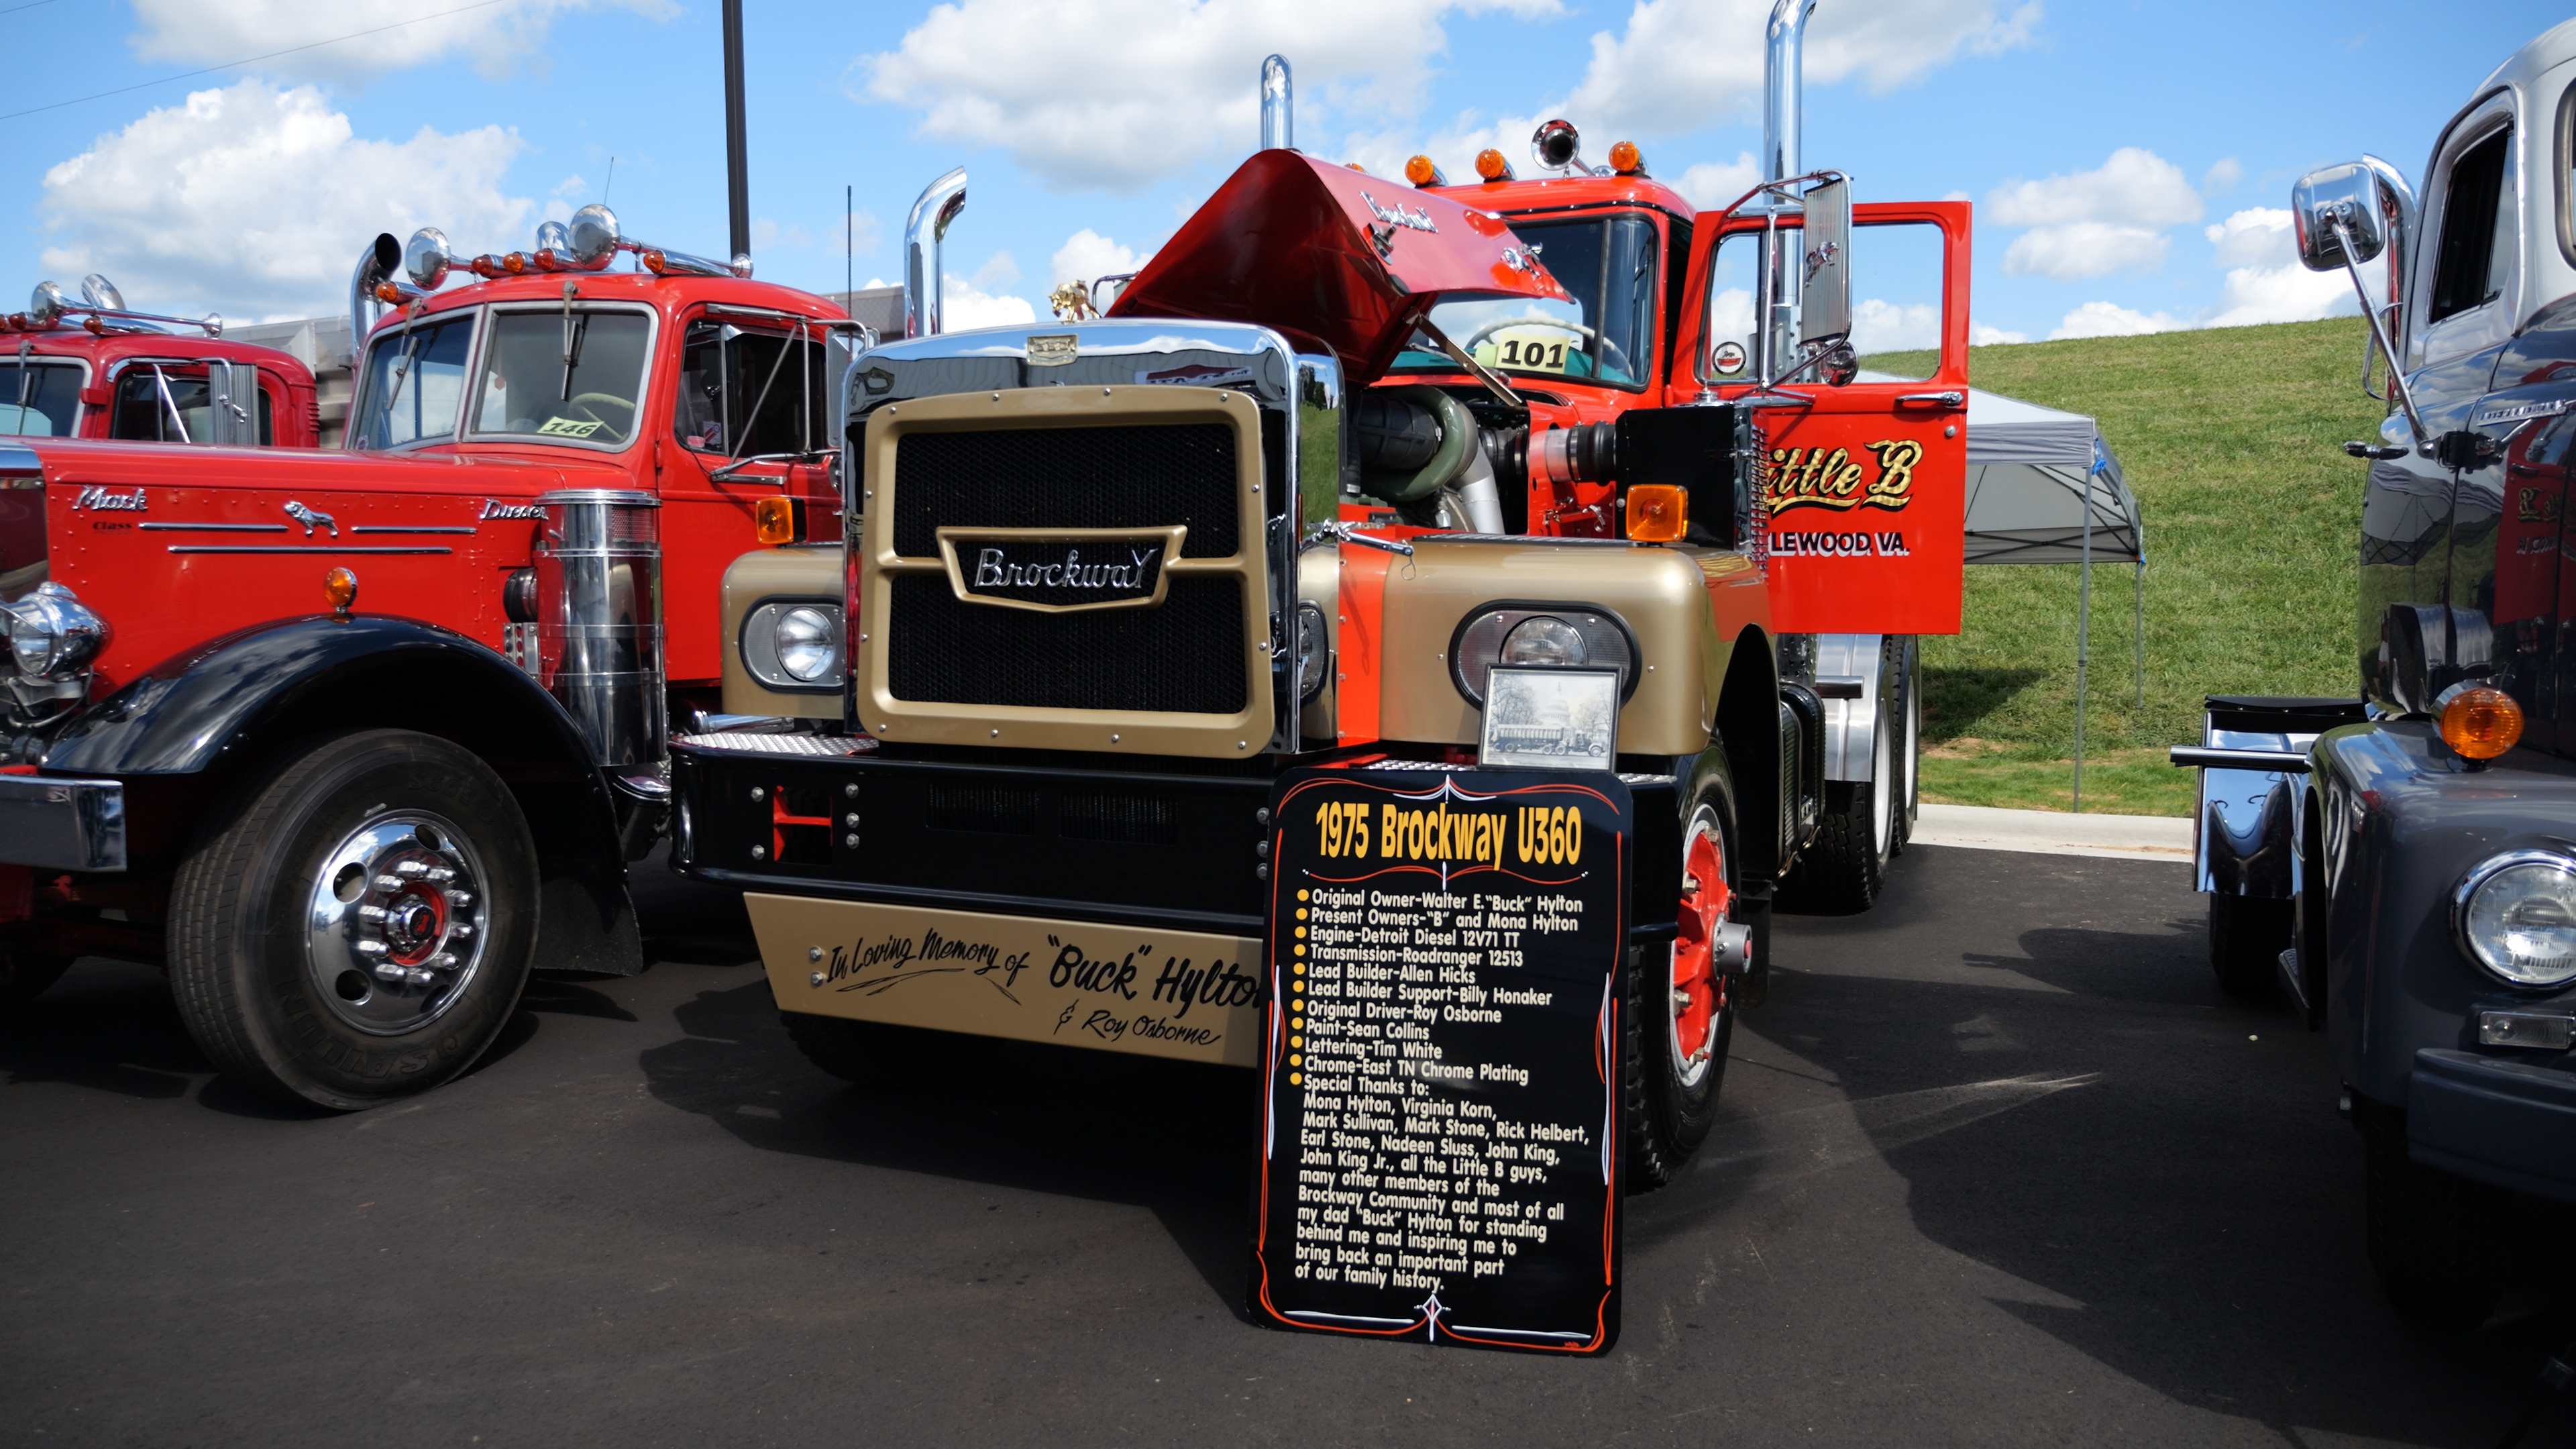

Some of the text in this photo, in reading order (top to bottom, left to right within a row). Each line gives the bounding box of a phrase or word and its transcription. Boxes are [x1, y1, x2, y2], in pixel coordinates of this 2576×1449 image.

[1501, 340, 1564, 368] 101
[543, 423, 597, 435] 146
[1768, 439, 1923, 518] ittle B
[72, 485, 148, 511] Mack
[93, 521, 132, 530] Class
[1874, 532, 1911, 557] VA.
[1316, 801, 1582, 871] 1975 Brockway U360
[1312, 889, 1364, 911] Original
[1371, 891, 1467, 909] Owner-Walter
[1538, 896, 1582, 918] Hylton
[1311, 907, 1363, 924] Present
[1456, 912, 1481, 928] and
[1488, 913, 1526, 929] Mona
[1533, 914, 1578, 934] Hylton
[1311, 926, 1519, 949] Engine-Detroit Diesel 12V71 TT
[826, 946, 848, 983] In
[852, 935, 916, 975] Loving
[918, 927, 1002, 975] Memory
[1005, 951, 1030, 987] of
[1311, 944, 1523, 970] Transmission-Roadranger 12513
[1309, 963, 1475, 983] Lead Builder-Allen Hicks
[1309, 980, 1552, 1008] Lead Builder Support-Billy Honaker
[1307, 1000, 1501, 1025] Original Driver-Roy Osborne
[276, 979, 430, 1079] SAILUN
[1081, 1010, 1128, 1042] Roy
[1132, 1014, 1222, 1046] Osborne
[1306, 1019, 1429, 1040] Paint-Sean Collins
[1305, 1037, 1442, 1062] Lettering-Tim White
[1305, 1056, 1528, 1086] Chrome-East TN Chrome Plating
[1304, 1075, 1429, 1097] Special Thanks to:
[1303, 1093, 1497, 1122] Mona Hylton, Virginia Korn,
[1303, 1112, 1589, 1145] Mark Sullivan, Mark Stone, Rick Helbert,
[1301, 1130, 1560, 1166] Earl Stone, Nadeen Sluss, John King,
[1300, 1148, 1547, 1184] John King Jr., all the Little B guys,
[1299, 1171, 1499, 1196] many other members of the
[1299, 1186, 1564, 1220] Brockway Community and most of all
[1298, 1209, 1318, 1227] my
[1324, 1208, 1349, 1223] dad
[1408, 1213, 1452, 1236] Hylton
[1458, 1216, 1480, 1233] for
[1486, 1219, 1547, 1242] standing
[1297, 1224, 1517, 1256] behind me and inspiring me to
[1296, 1244, 1505, 1277] bring back an important part
[1295, 1264, 1444, 1293] of our family history.
